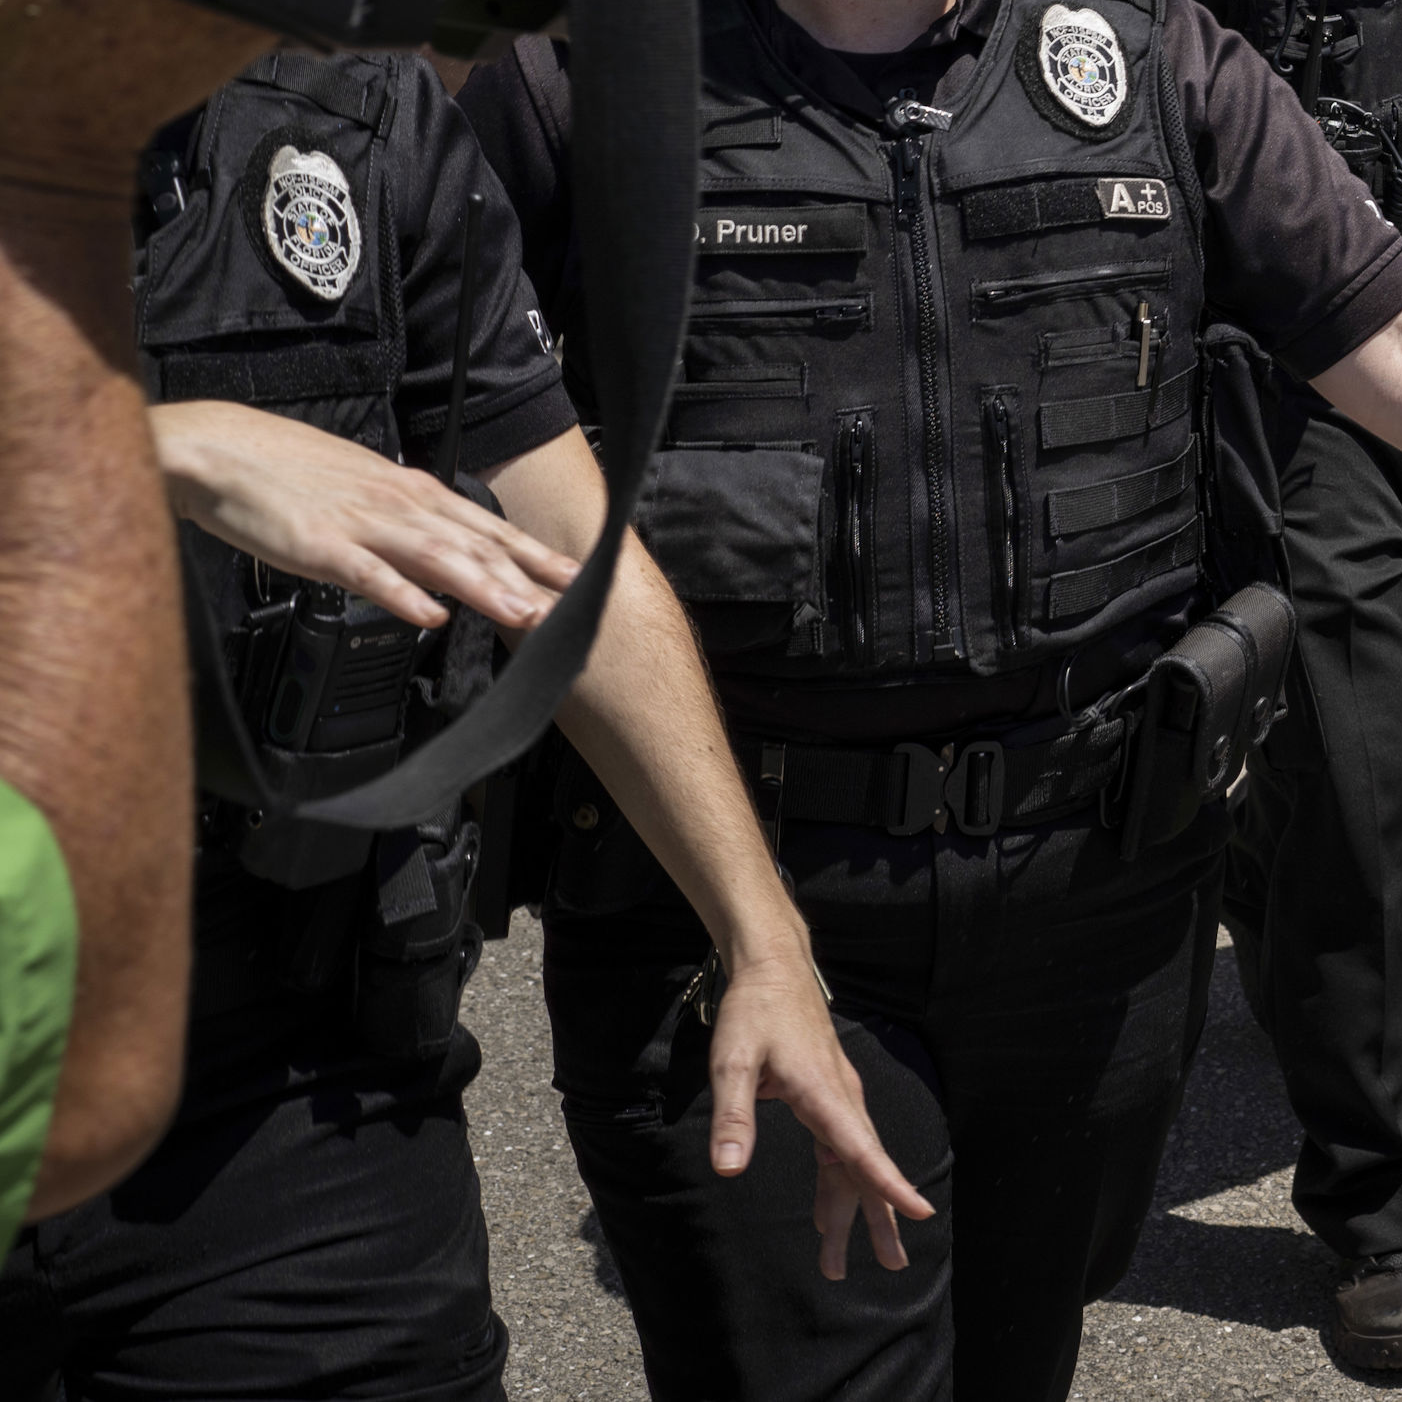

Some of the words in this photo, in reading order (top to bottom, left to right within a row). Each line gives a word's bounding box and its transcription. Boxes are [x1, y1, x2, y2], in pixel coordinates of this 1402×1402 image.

[1060, 35, 1097, 49] POLICE
[1061, 47, 1088, 64] STATE
[1090, 52, 1105, 67] OF
[1064, 74, 1107, 93] FLORIDA
[1063, 89, 1114, 107] OFFICER
[288, 186, 328, 204] POLICE
[287, 201, 317, 223] STATE
[320, 207, 336, 228] OF
[1137, 201, 1163, 214] POS
[717, 220, 808, 243] Pruner
[289, 234, 339, 259] FLORIDA
[290, 253, 346, 276] OFFICER
